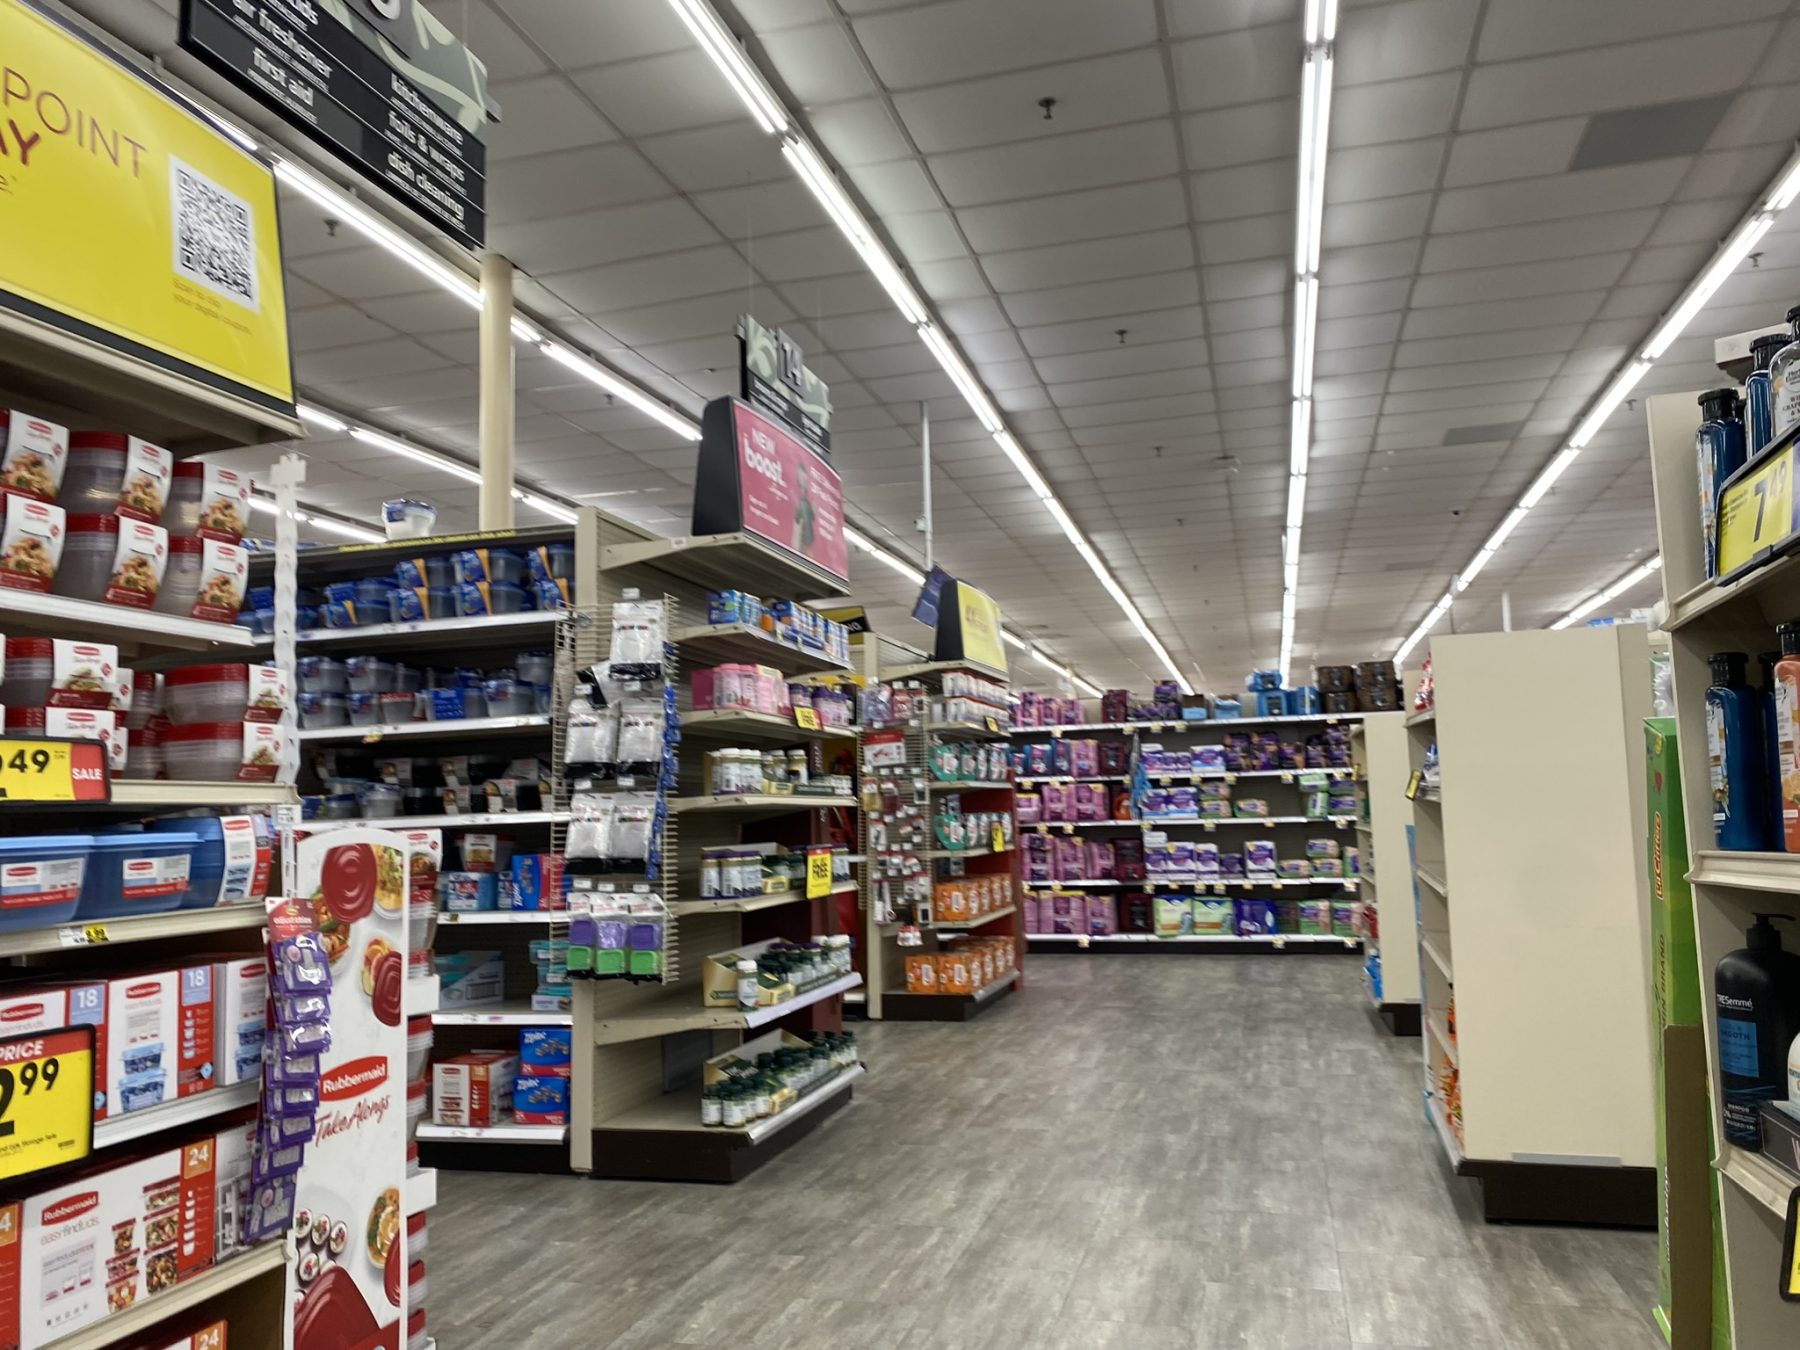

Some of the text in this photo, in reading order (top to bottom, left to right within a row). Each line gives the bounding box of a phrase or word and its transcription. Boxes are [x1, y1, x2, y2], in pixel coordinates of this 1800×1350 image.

[4, 66, 147, 178] POINT
[0, 118, 42, 166] Y
[72, 768, 103, 781] SALE
[189, 970, 205, 988] 18
[79, 989, 98, 1008] 18
[322, 1063, 386, 1094] Rubbermaid
[188, 1144, 207, 1166] 24
[44, 1195, 97, 1222] Rubbermaid
[200, 1328, 220, 1350] 24
